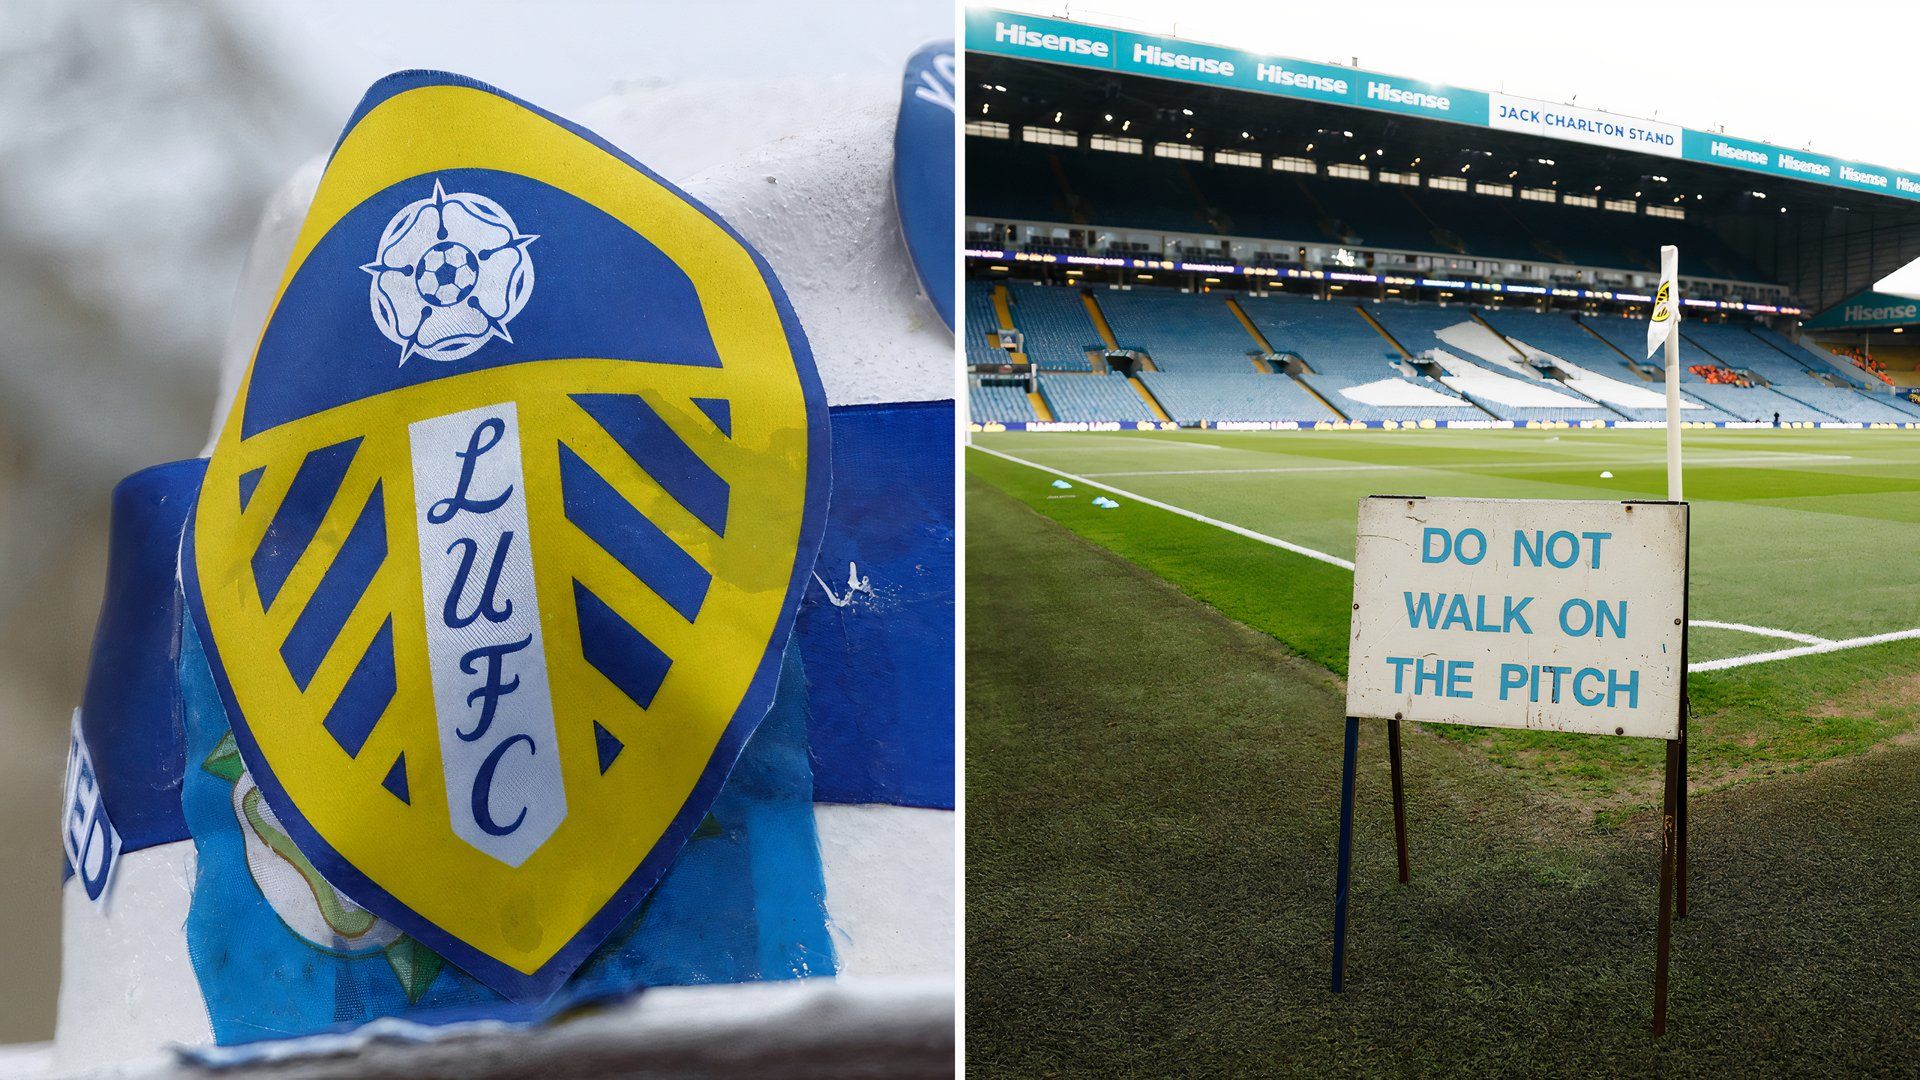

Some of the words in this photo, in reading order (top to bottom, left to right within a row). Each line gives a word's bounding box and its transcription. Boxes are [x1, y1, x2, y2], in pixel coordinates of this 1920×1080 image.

[995, 22, 1109, 58] Hisense
[1133, 43, 1235, 77] Hisense
[1256, 63, 1348, 95] Hisense
[1367, 81, 1450, 110] Hisense
[1500, 105, 1540, 123] JACK
[1545, 113, 1624, 138] CHARLTON
[1629, 127, 1674, 146] STAND
[1711, 140, 1768, 166] Hisense
[1778, 153, 1831, 177] Hisense
[1839, 165, 1888, 188] Hisense
[1844, 304, 1917, 322] Hisense
[1422, 527, 1487, 566] DO
[1513, 529, 1612, 569] NOT
[1403, 591, 1534, 634] WALK
[1558, 598, 1628, 639] ON
[1385, 656, 1475, 699] THE
[1499, 663, 1640, 709] PITCH
